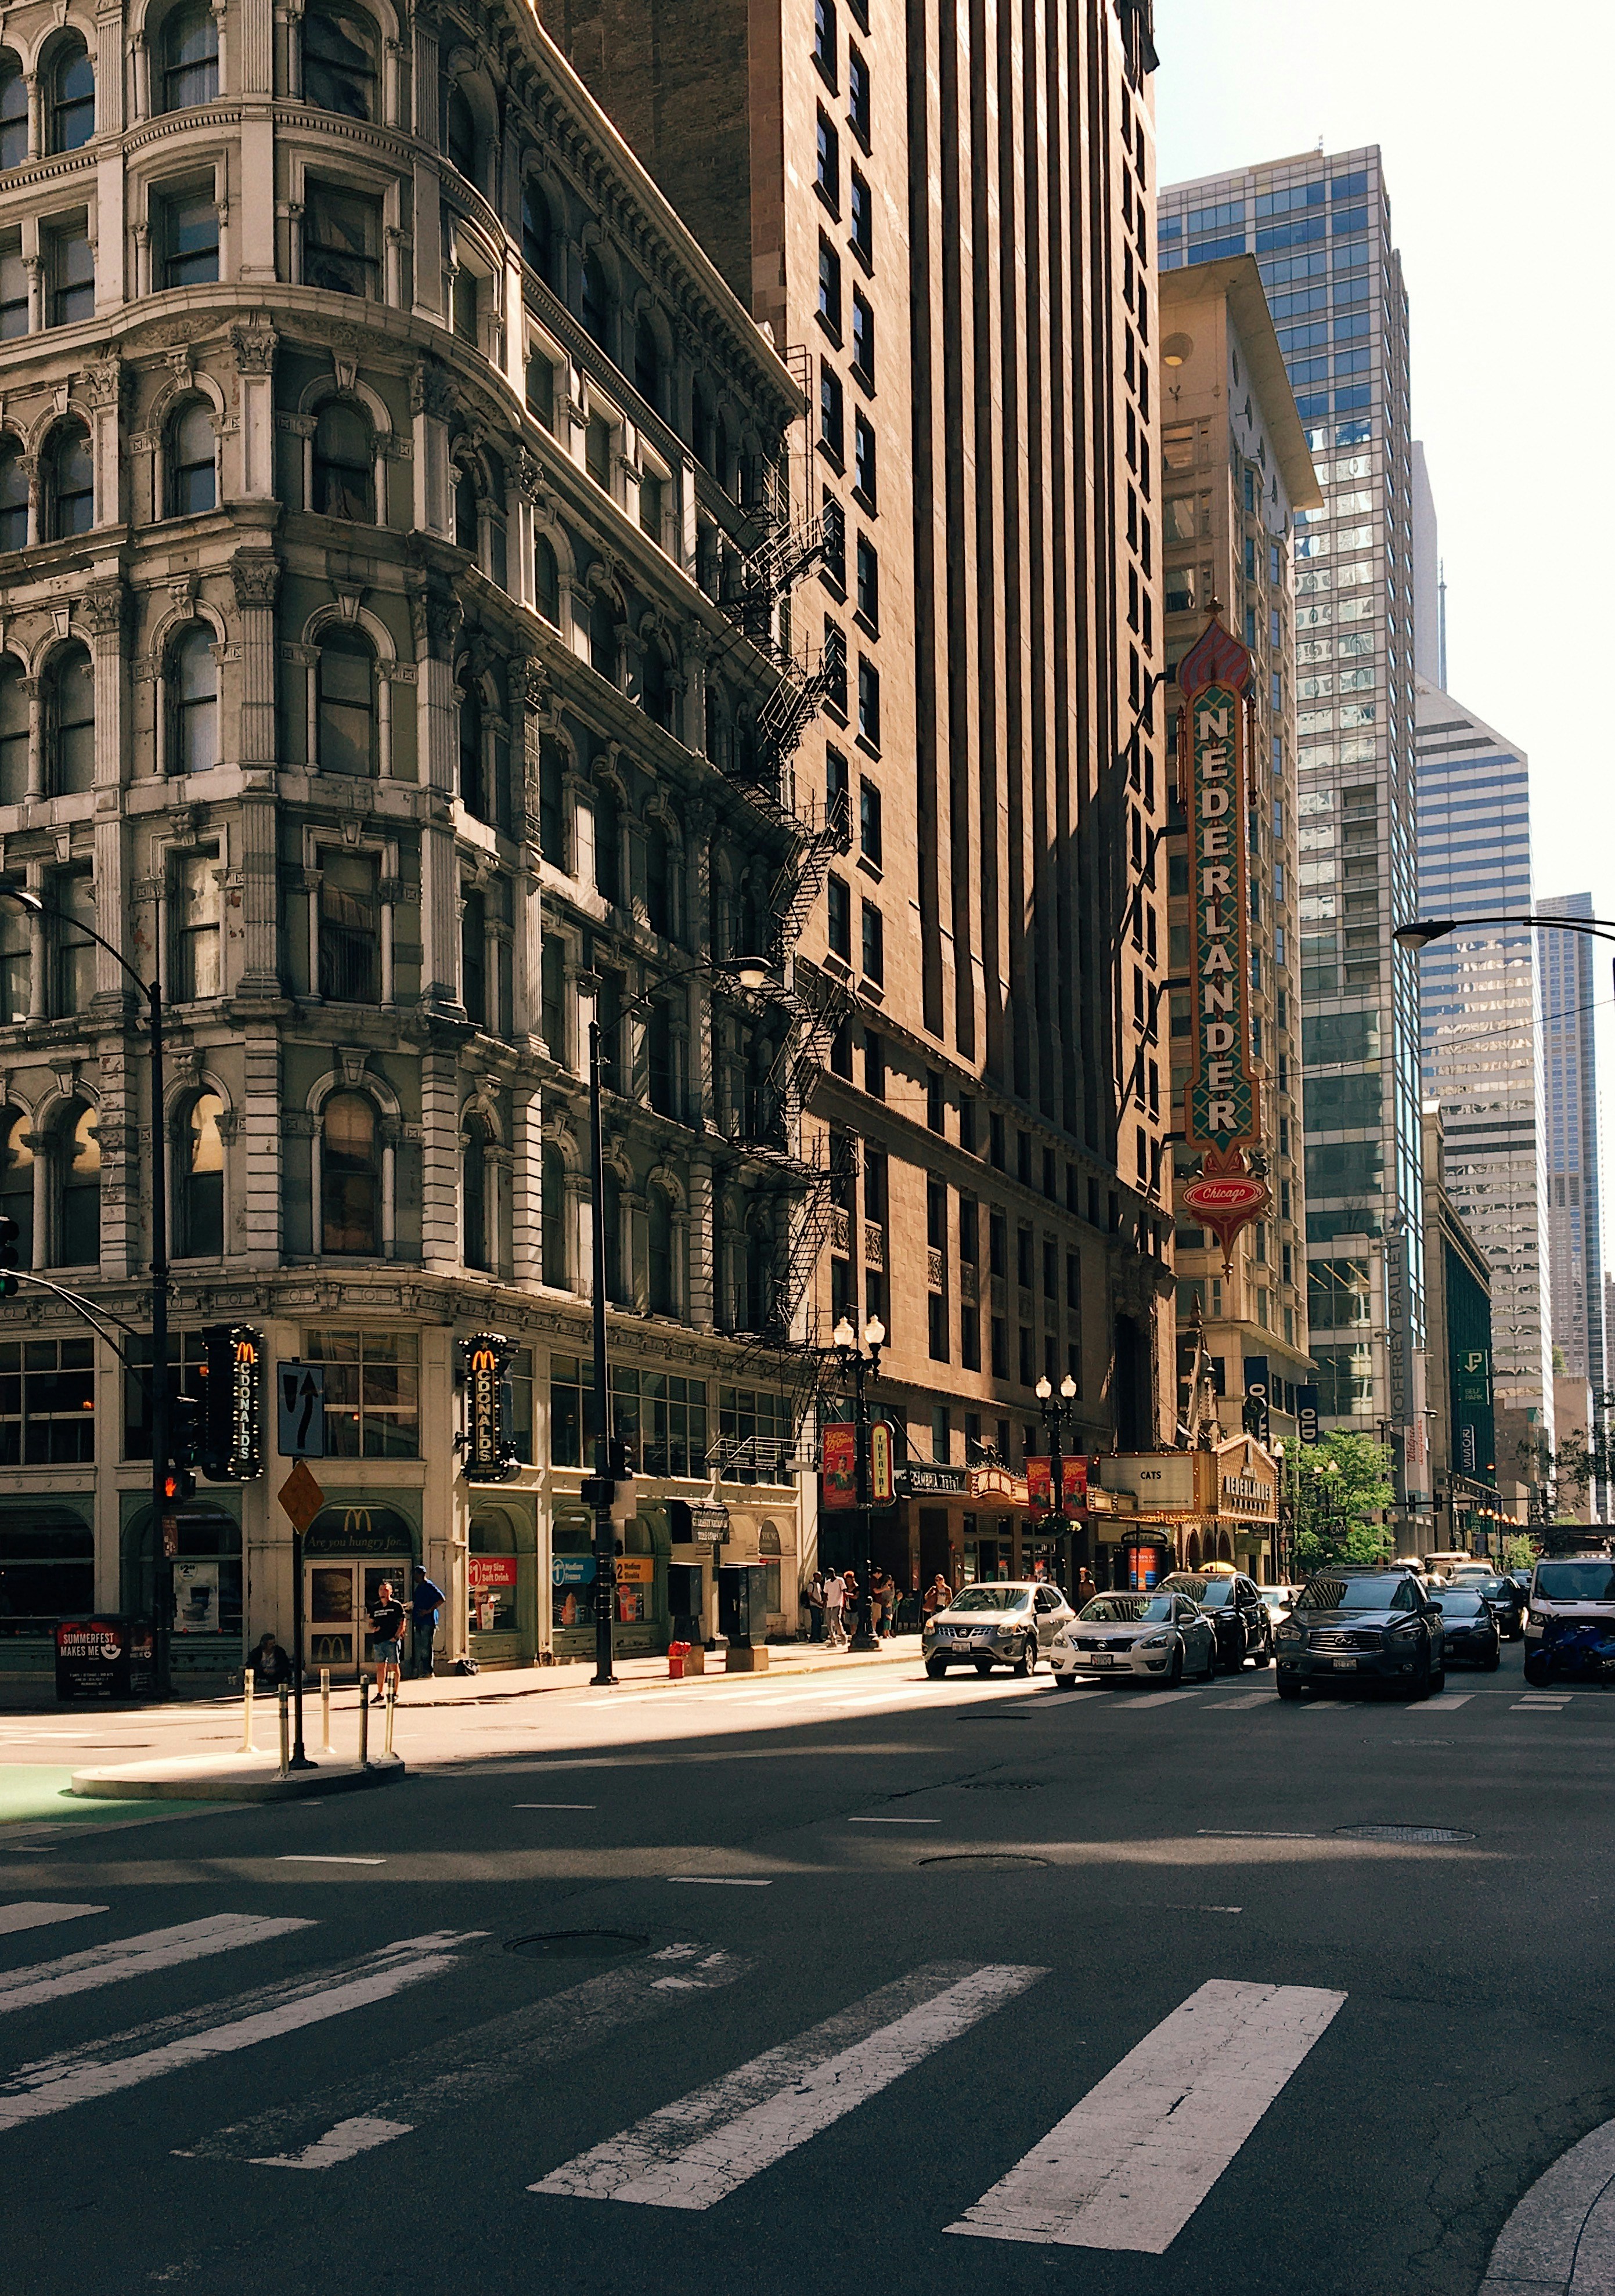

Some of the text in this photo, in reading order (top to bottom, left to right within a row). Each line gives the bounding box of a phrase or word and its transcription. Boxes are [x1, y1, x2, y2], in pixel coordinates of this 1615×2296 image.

[1199, 707, 1238, 1131] NEDERLANDER
[1203, 1186, 1246, 1203] Chicago
[1389, 1243, 1401, 1322] BALLET
[1462, 1429, 1472, 1467] ROSS
[1140, 1471, 1162, 1479] CATS
[1278, 1518, 1294, 1529] CATS
[1331, 1525, 1346, 1535] CATS
[308, 1537, 325, 1547] Are
[329, 1540, 346, 1551] you
[348, 1535, 384, 1550] hungry
[482, 1562, 492, 1573] Any
[493, 1562, 504, 1571] Size
[482, 1573, 509, 1582] Soft Drink
[63, 1633, 114, 1645] SUMMERFEST
[60, 1645, 100, 1656] MAKES ME
